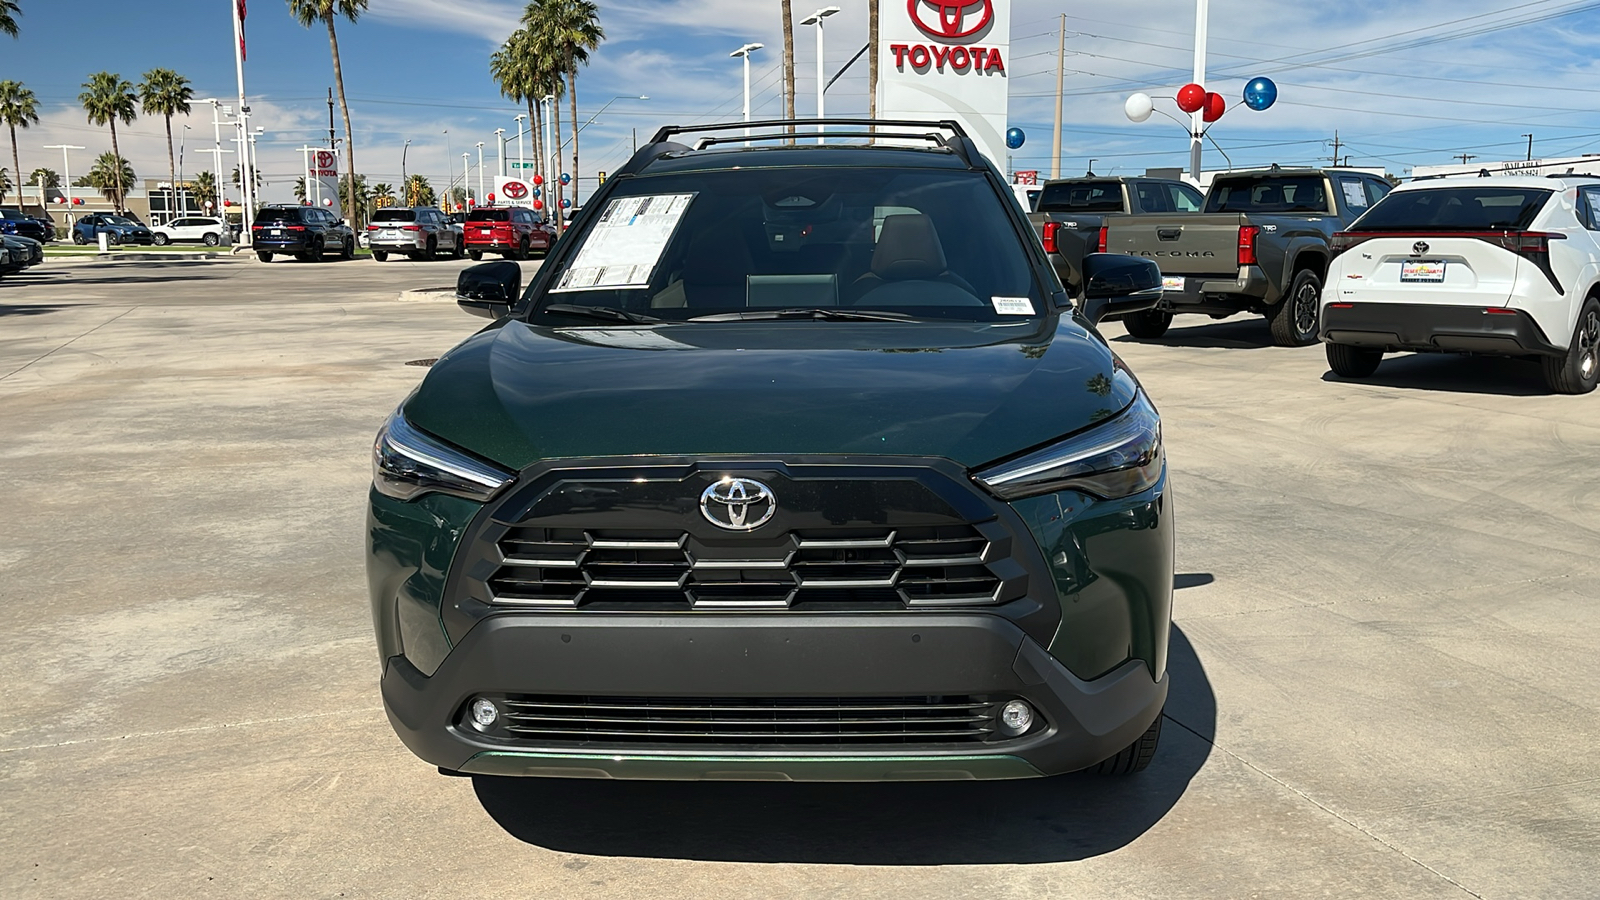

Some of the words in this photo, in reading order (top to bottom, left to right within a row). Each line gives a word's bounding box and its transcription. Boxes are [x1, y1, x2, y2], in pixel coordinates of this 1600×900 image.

[890, 44, 1005, 72] TOYOTA
[1262, 224, 1277, 232] TRD
[1125, 250, 1215, 258] TACOMA
